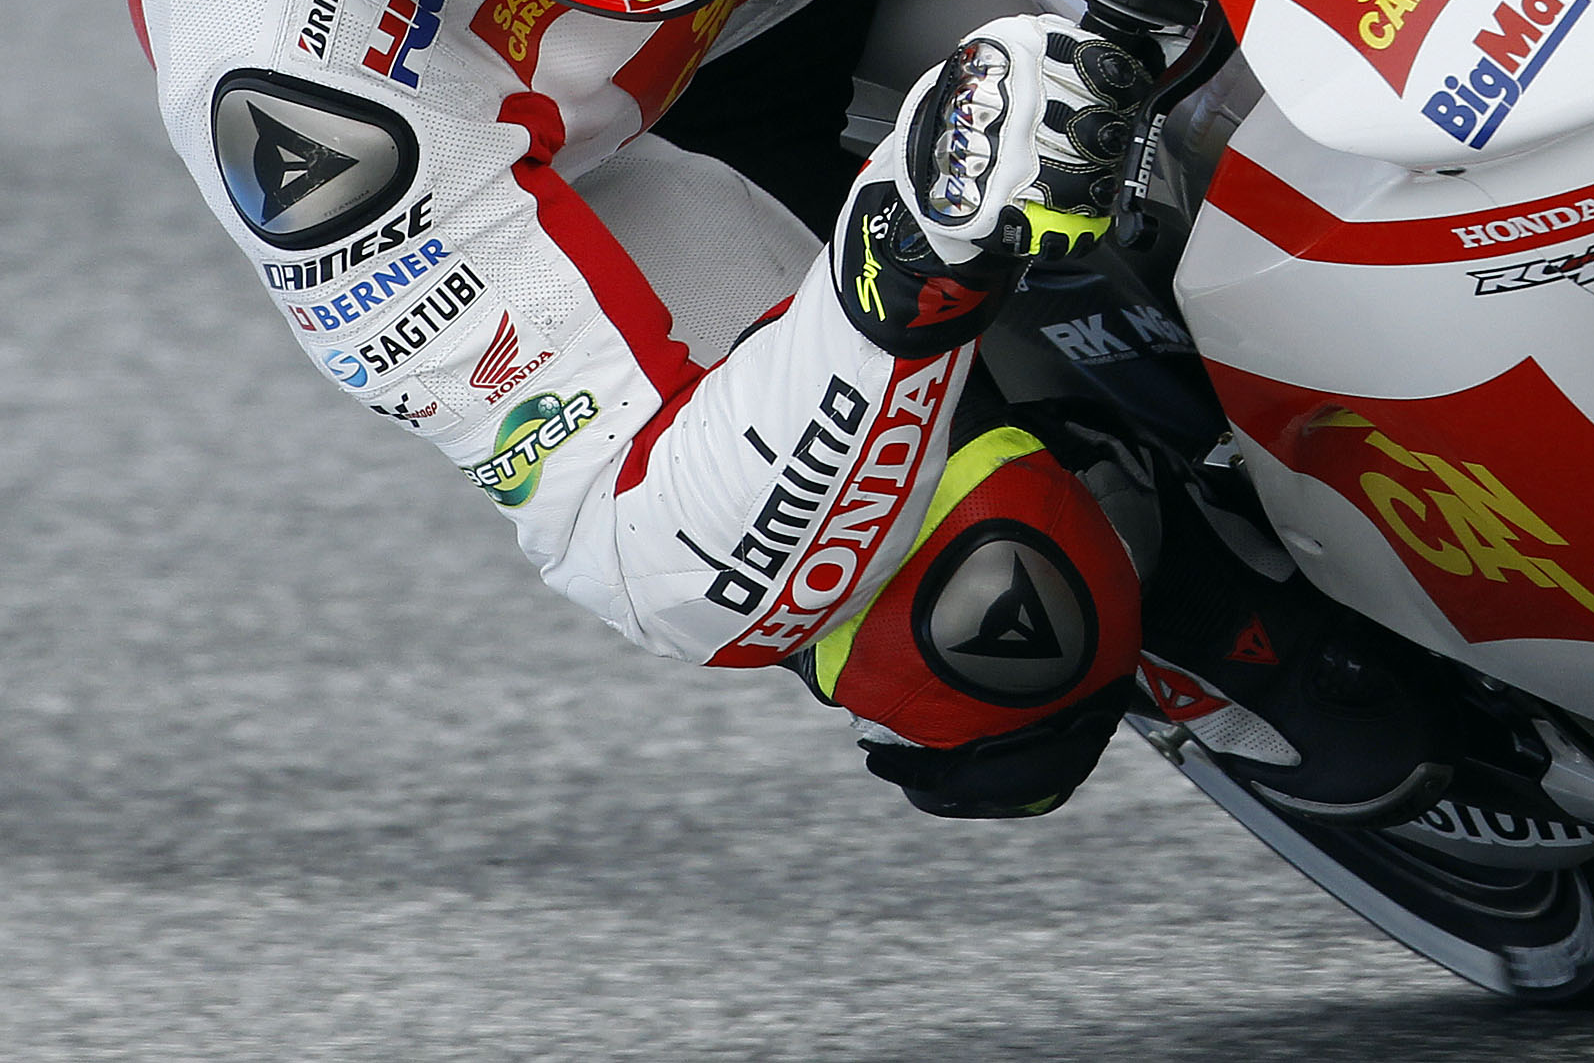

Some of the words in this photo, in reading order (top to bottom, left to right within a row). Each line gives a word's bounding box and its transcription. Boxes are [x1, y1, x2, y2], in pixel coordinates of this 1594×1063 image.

[1123, 112, 1168, 199] domino
[869, 200, 898, 240] Si
[310, 237, 454, 332] BERNER
[358, 262, 487, 375] SAGTUBI
[484, 348, 555, 406] HONDA
[1039, 312, 1133, 361] RK
[463, 394, 598, 488] BETTER
[676, 373, 871, 617] domino
[736, 349, 953, 653] HONDA
